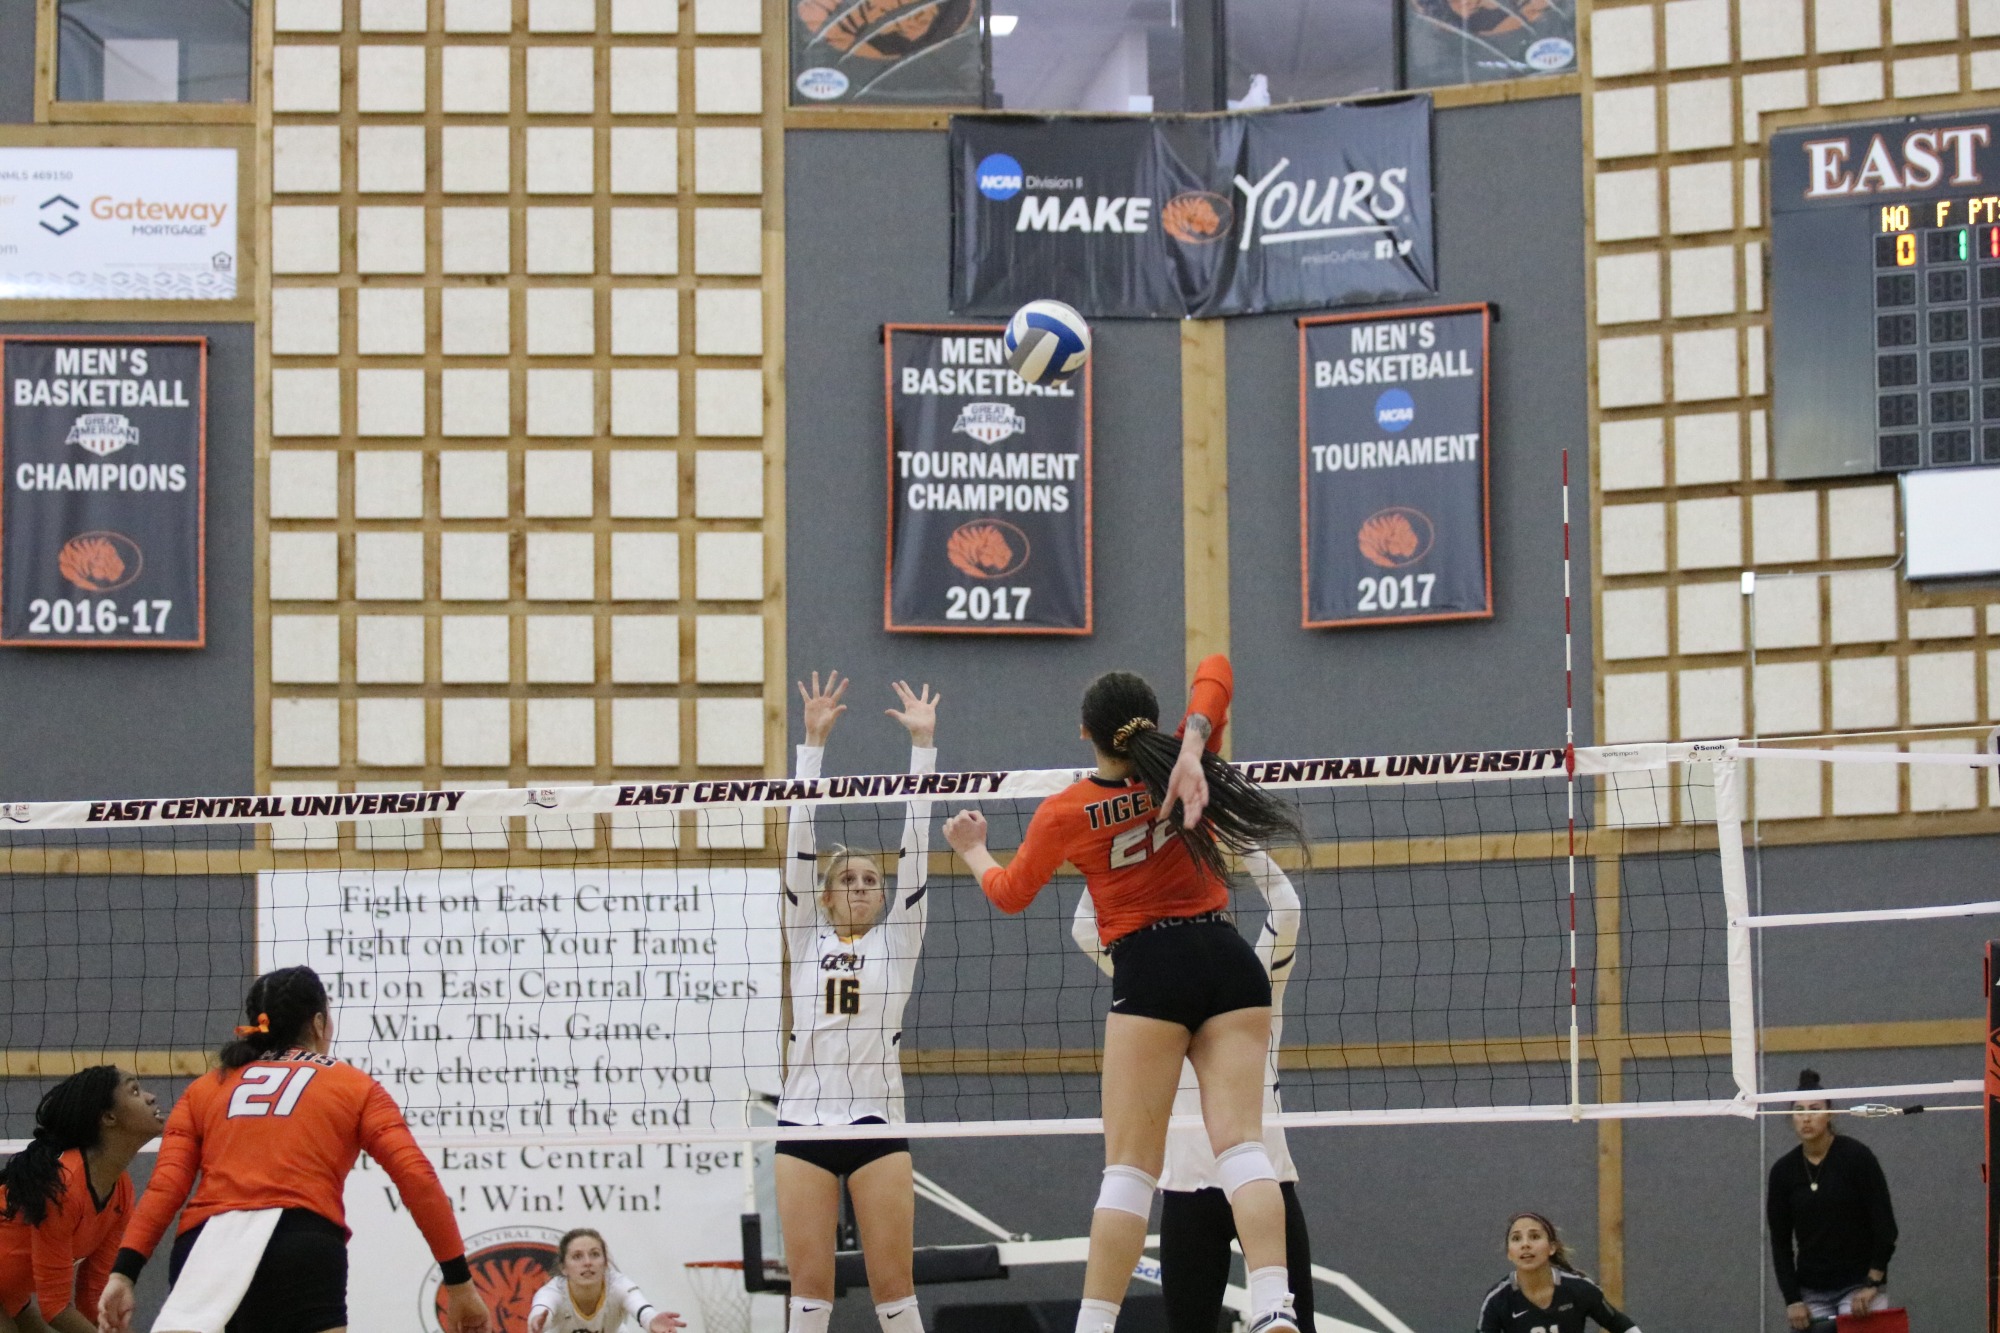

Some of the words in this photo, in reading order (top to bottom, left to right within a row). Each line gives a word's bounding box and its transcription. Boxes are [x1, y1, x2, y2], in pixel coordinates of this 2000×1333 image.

[1804, 125, 1989, 197] EAST
[980, 175, 1023, 190] NCAA
[1025, 175, 1074, 190] Division
[90, 195, 227, 227] Gateway
[1015, 196, 1152, 233] MAKE
[1881, 205, 1909, 232] NO
[1936, 201, 1951, 227] F
[1968, 196, 2000, 225] PT
[132, 224, 207, 236] MORTGAGE
[1896, 233, 1916, 266] 0
[1959, 229, 1967, 260] 1
[941, 337, 1003, 365] MEN
[1351, 321, 1435, 354] MEN'S
[55, 348, 148, 376] MEN'S
[1315, 350, 1474, 388] BASKETBALL
[14, 378, 189, 407] BASKETBALL
[84, 416, 120, 426] GREAT
[954, 415, 1025, 431] AMERICAN
[971, 404, 1007, 415] GREAT
[1378, 408, 1414, 423] NCAA
[69, 424, 137, 440] AMERICAN
[897, 451, 1080, 480] TOURNAMENT
[1311, 433, 1480, 473] TOURNAMENT
[16, 463, 187, 492] CHAMPIONS
[907, 483, 1069, 512] CHAMPIONS
[945, 586, 1032, 621] 2017
[1358, 573, 1436, 612] 2017
[28, 598, 172, 633] 2016-17
[1245, 757, 1380, 783] CENTRAL
[1385, 749, 1567, 777] UNIVERSITY
[615, 783, 689, 806] EAST
[693, 779, 823, 803] CENTRAL
[829, 772, 1009, 798] UNIVERSITY
[86, 800, 158, 822] EAST
[160, 796, 286, 820] CENTRAL
[291, 791, 466, 816] UNIVERSITY
[1084, 792, 1157, 830] TIGE
[342, 885, 426, 919] Fight
[440, 895, 480, 913] on
[496, 885, 562, 913] East
[576, 884, 702, 913] Central
[325, 928, 409, 961] Fight
[424, 937, 464, 955] on
[479, 928, 525, 955] for
[538, 928, 618, 955] Your
[632, 928, 717, 955] Fame
[325, 971, 370, 1003] ght
[384, 980, 423, 998] on
[440, 970, 506, 998] East
[518, 970, 645, 998] Central
[656, 971, 758, 1003] Tigers
[826, 978, 860, 1014] 16
[372, 1014, 454, 1041] Win.
[467, 1012, 550, 1040] This.
[565, 1012, 671, 1041] Game.
[438, 1056, 579, 1089] cheering
[593, 1055, 640, 1083] for
[654, 1066, 711, 1089] you
[227, 1066, 317, 1120] 21
[404, 1101, 505, 1132] eering
[520, 1099, 552, 1126] til
[568, 1098, 617, 1126] the
[631, 1098, 691, 1126] end
[442, 1146, 507, 1169] East
[519, 1144, 644, 1169] Central
[481, 1184, 564, 1212] Win!
[579, 1184, 661, 1212] Win!
[473, 1229, 530, 1248] ENTRAL
